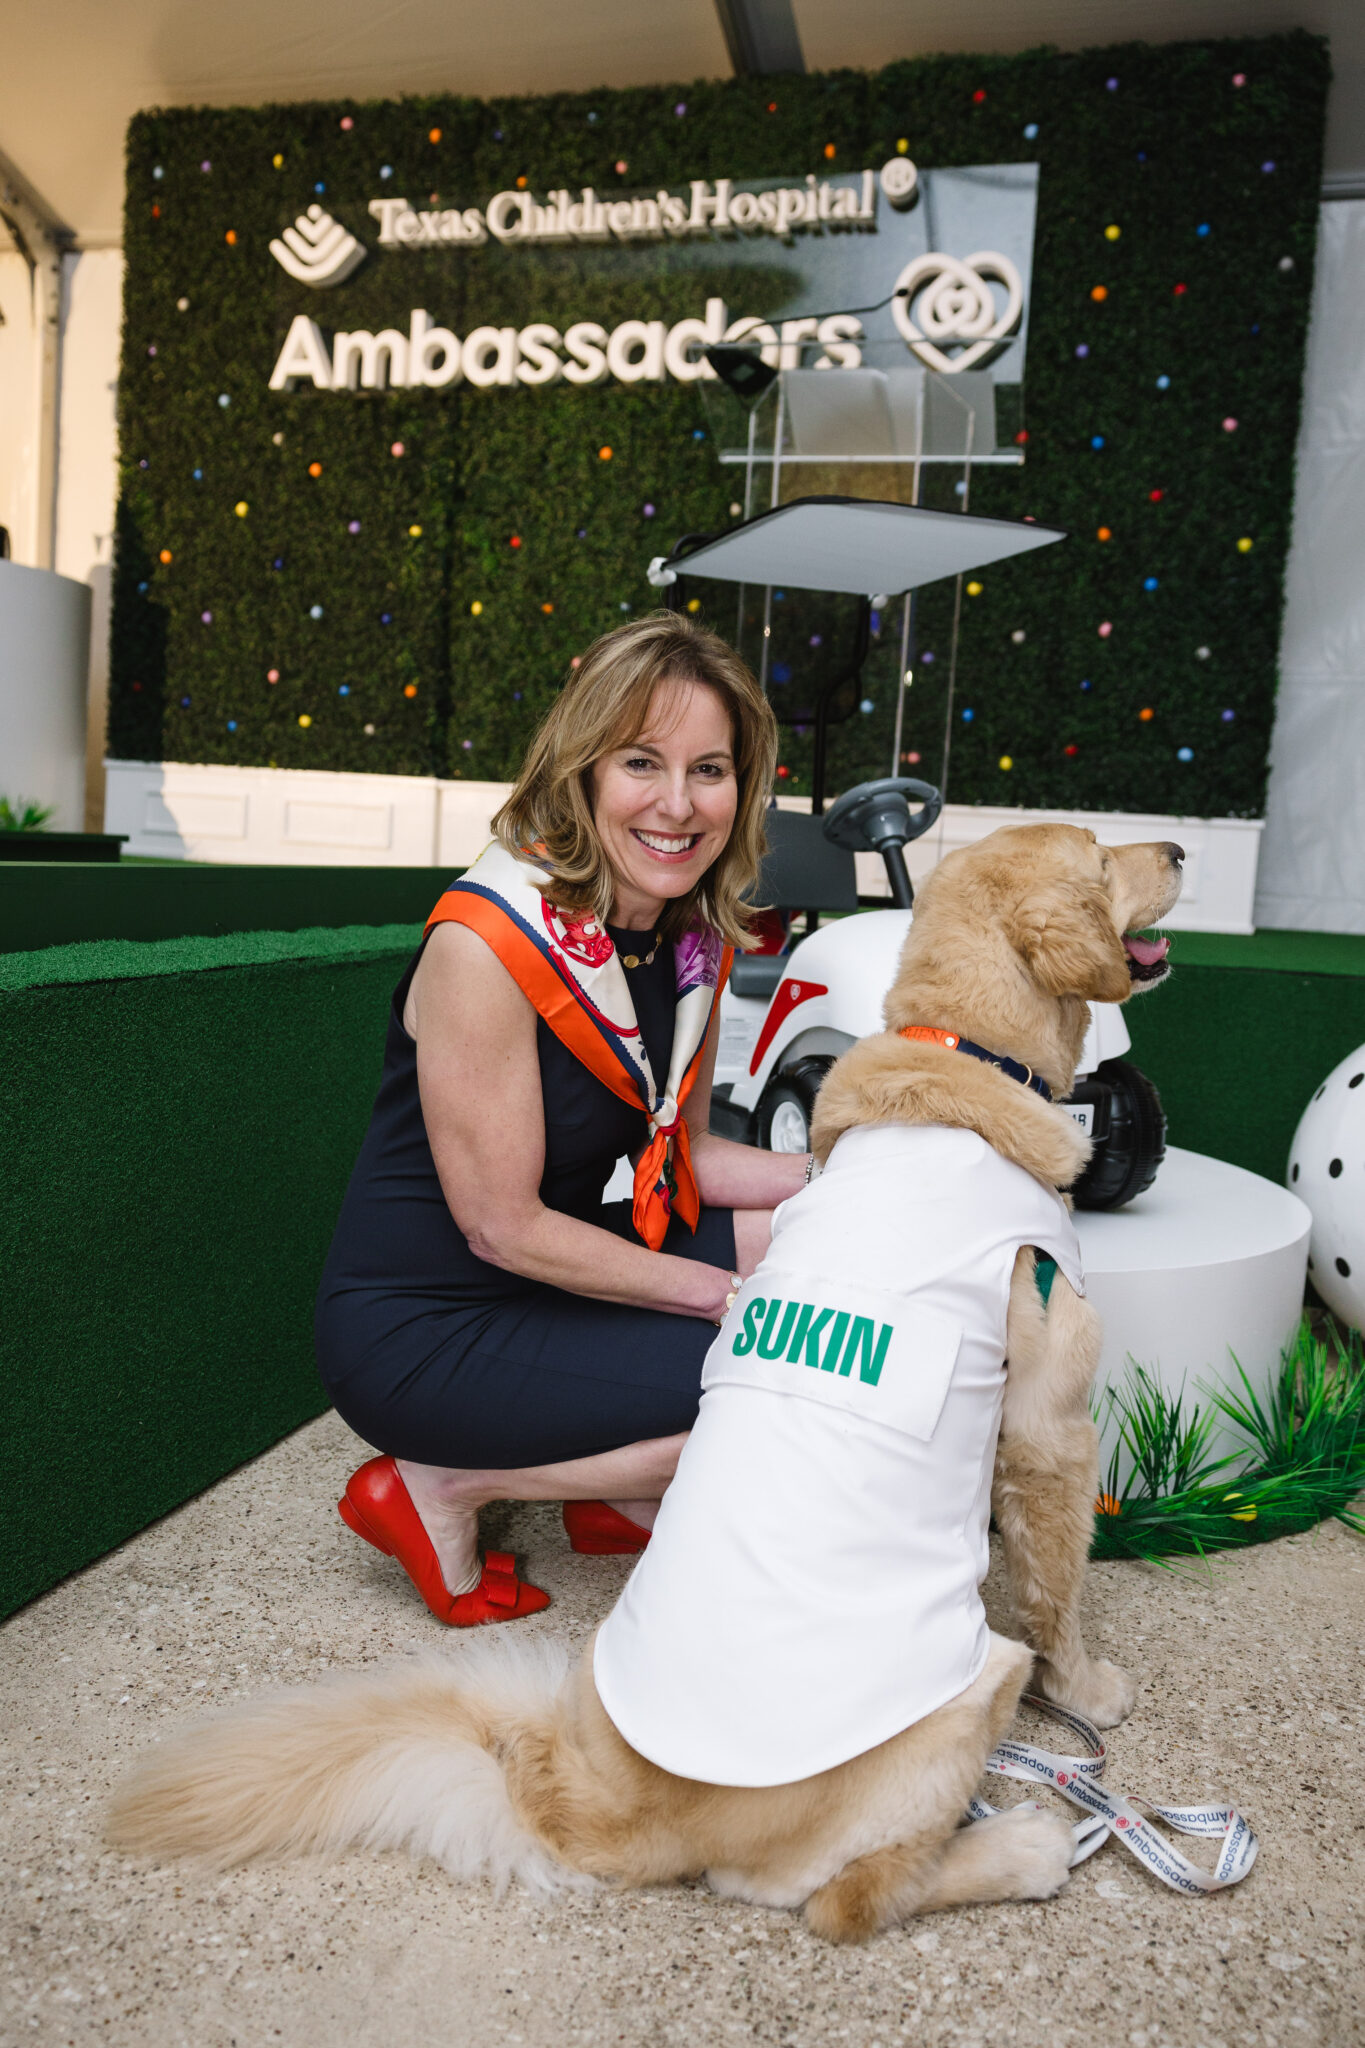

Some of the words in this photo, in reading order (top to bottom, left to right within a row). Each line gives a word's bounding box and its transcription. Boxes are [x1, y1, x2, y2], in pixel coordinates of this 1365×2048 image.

[368, 198, 488, 247] Texas
[486, 187, 688, 243] Children's
[688, 168, 876, 238] Hospital
[268, 297, 864, 392] Ambassadors
[732, 1297, 894, 1387] SUKIN
[1065, 1780, 1118, 1820] Ambassadors
